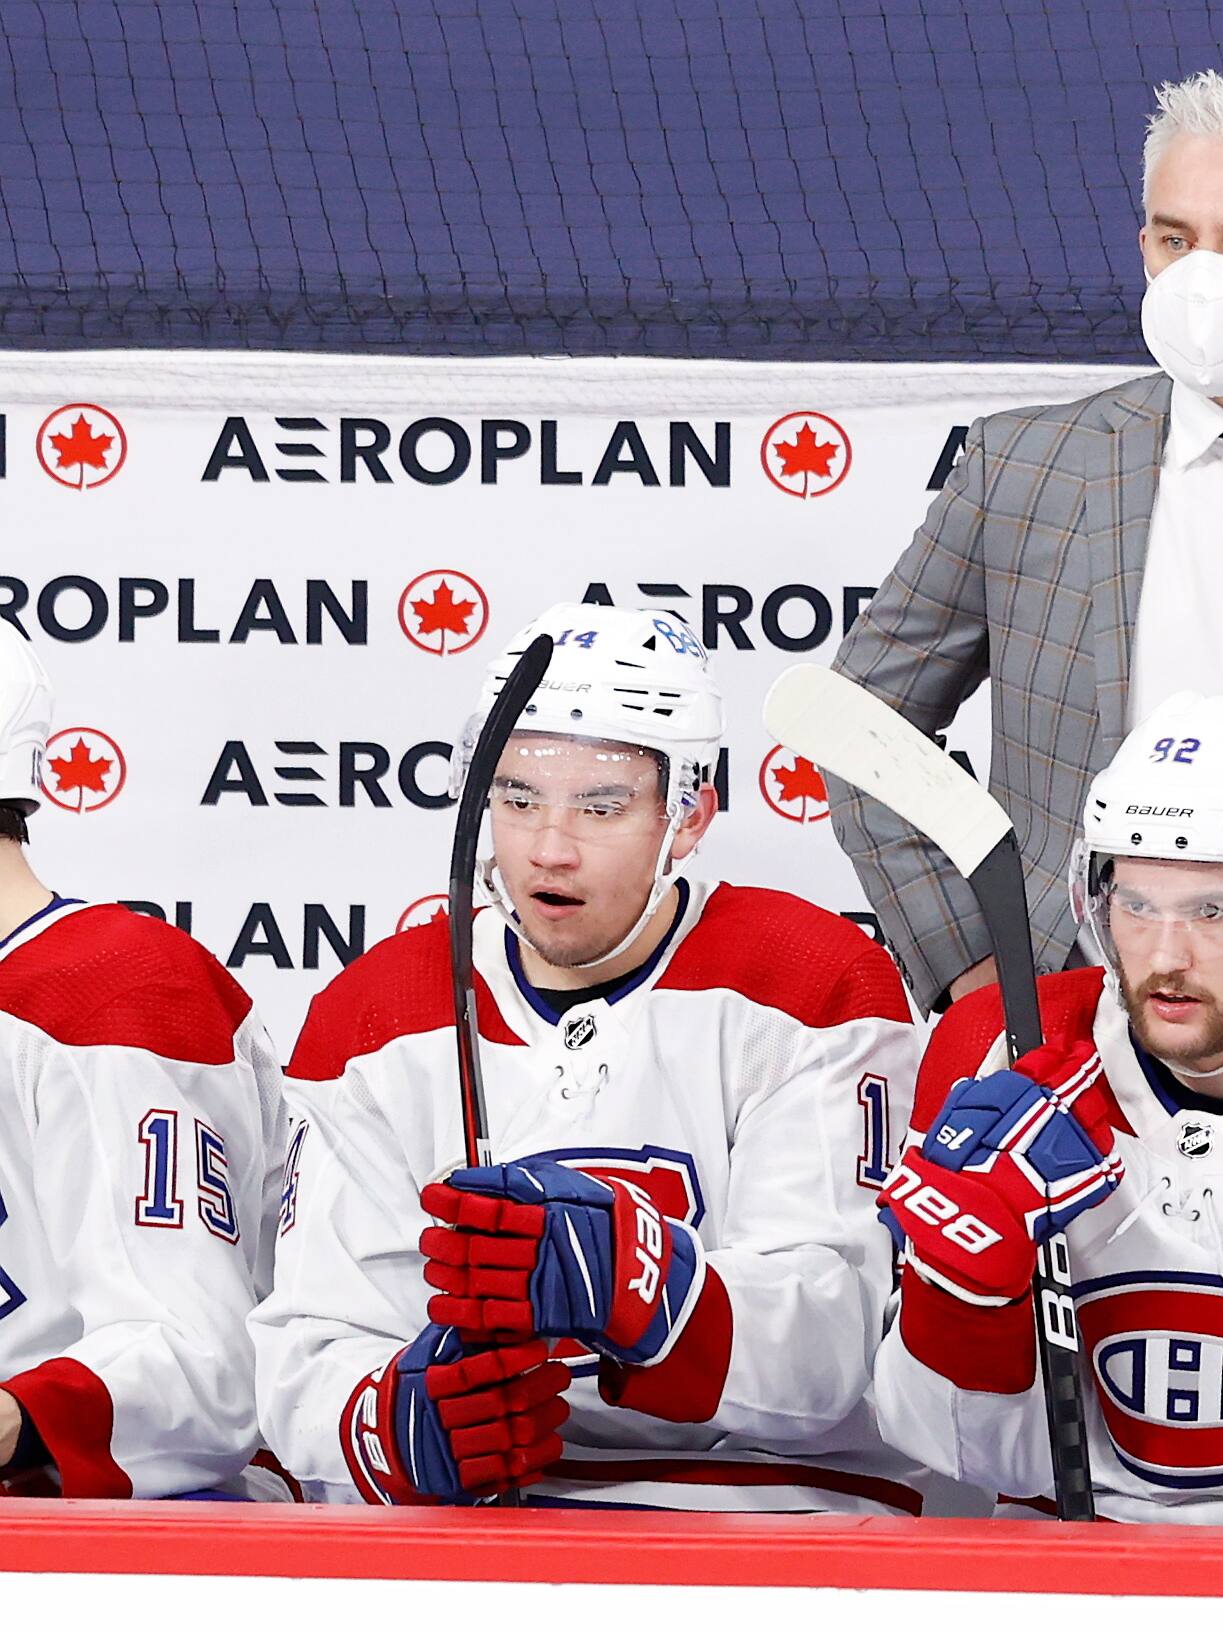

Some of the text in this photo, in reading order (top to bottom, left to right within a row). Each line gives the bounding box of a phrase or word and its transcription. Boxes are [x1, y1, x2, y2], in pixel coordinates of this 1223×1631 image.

[200, 416, 731, 488] AEROPLAN
[554, 629, 598, 649] 14
[537, 680, 592, 694] AUER
[1149, 737, 1201, 765] 92
[1124, 804, 1195, 818] BAUER
[856, 1072, 907, 1191] 1
[134, 1108, 240, 1246] 15
